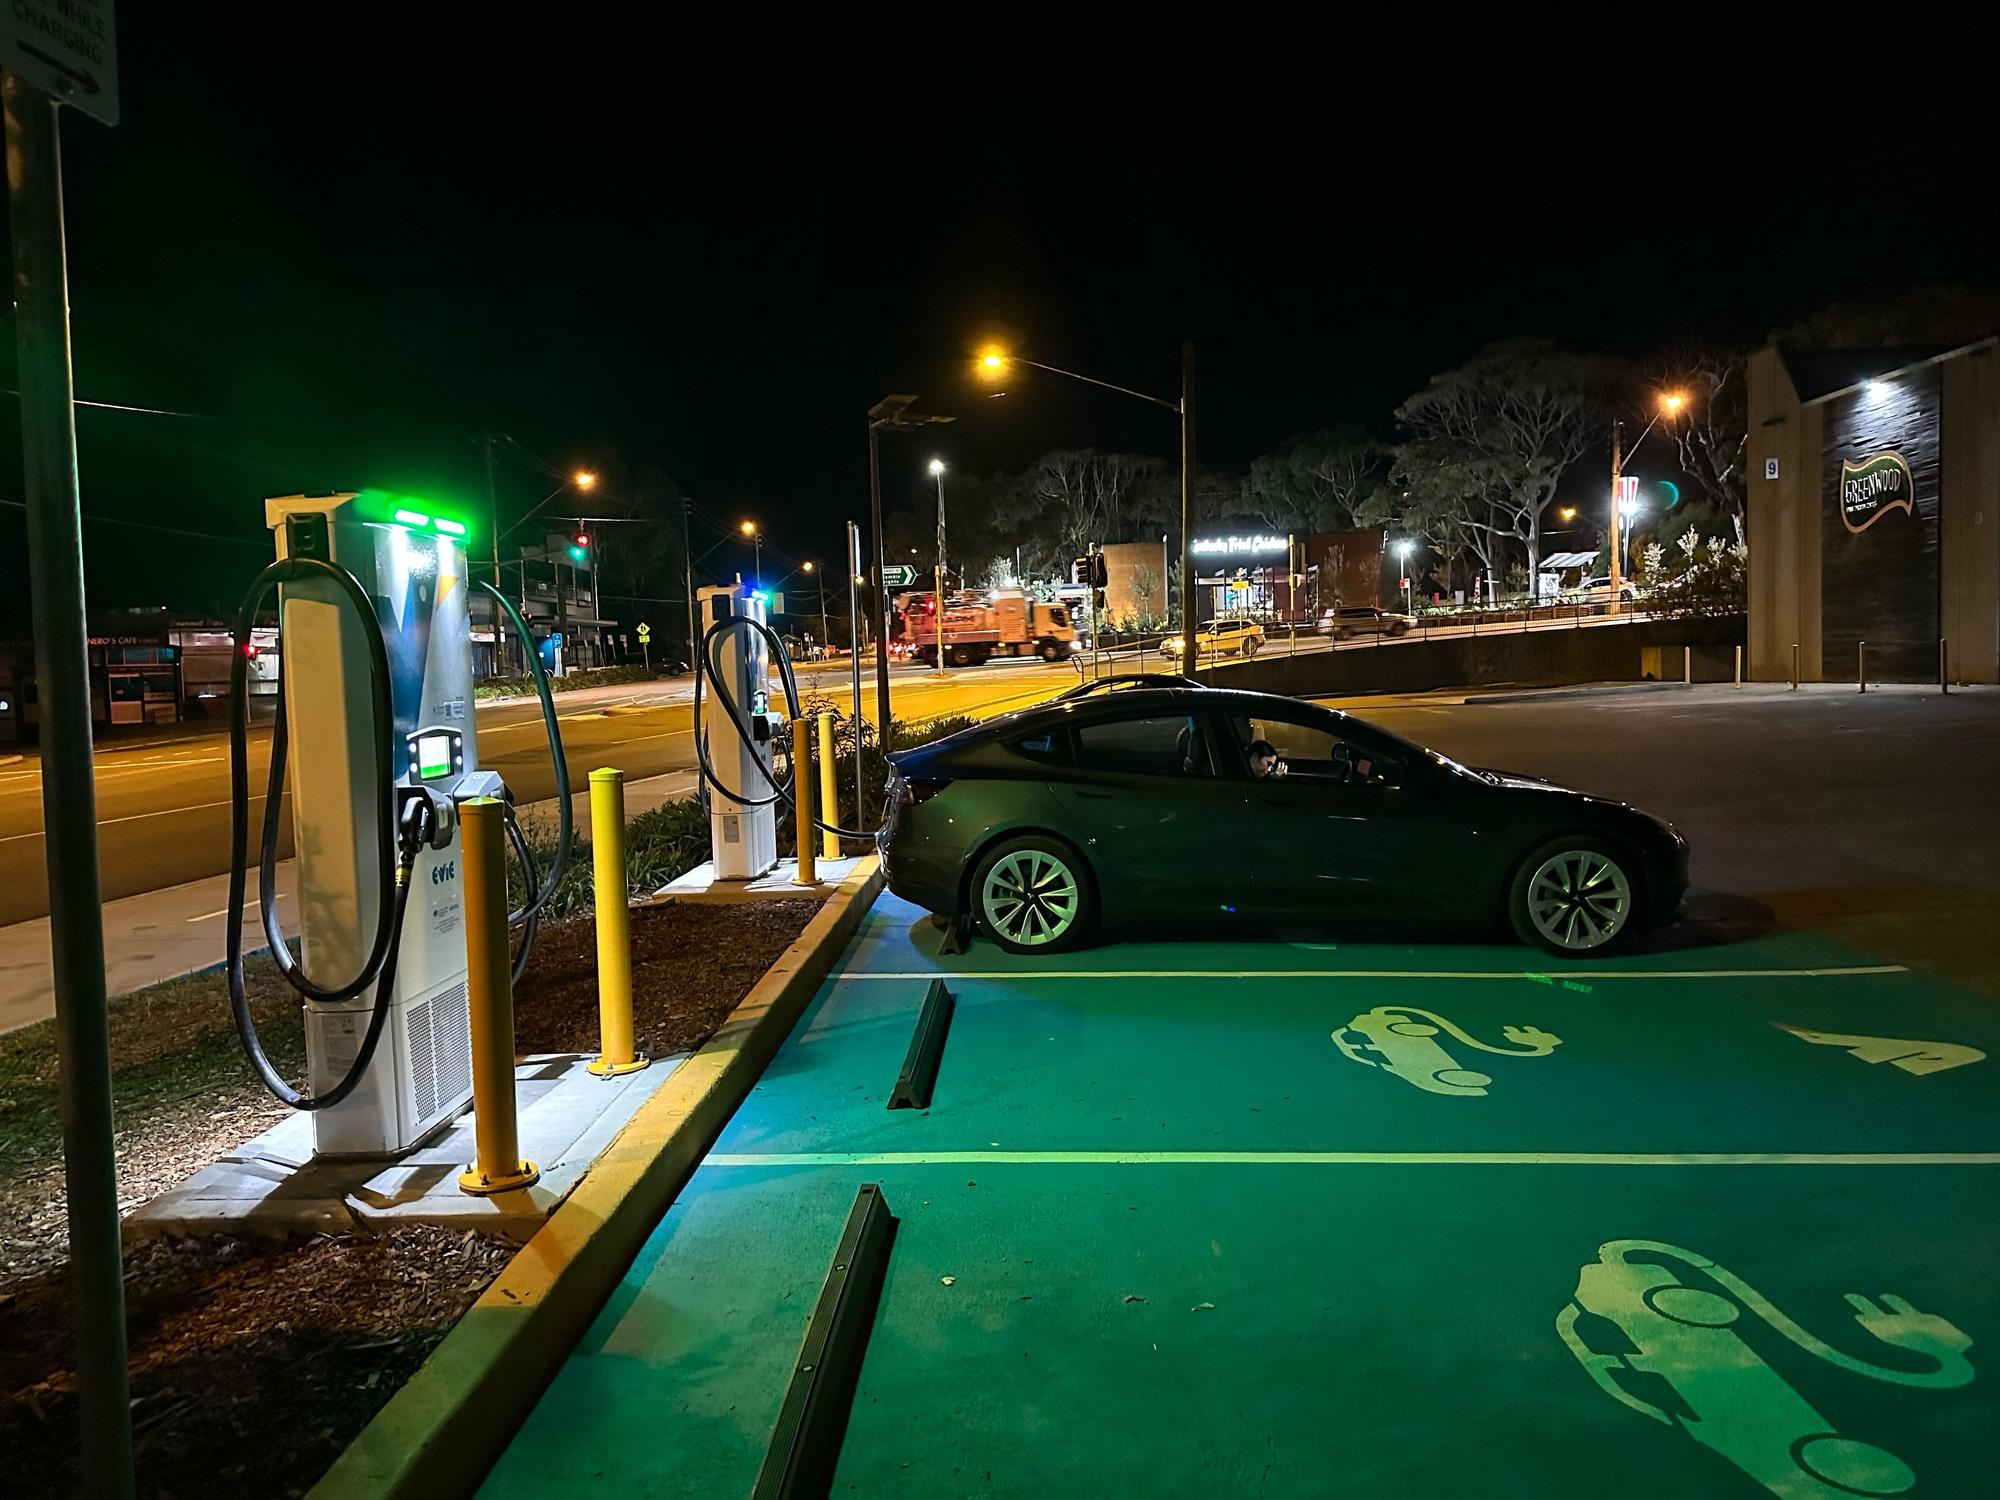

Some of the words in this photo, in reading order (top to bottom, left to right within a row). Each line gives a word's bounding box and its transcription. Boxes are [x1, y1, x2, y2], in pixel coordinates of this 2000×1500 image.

[14, 0, 103, 65] CHARGING
[1768, 462, 1776, 475] 9
[1845, 468, 1901, 504] GREENWOOD
[554, 639, 561, 647] P
